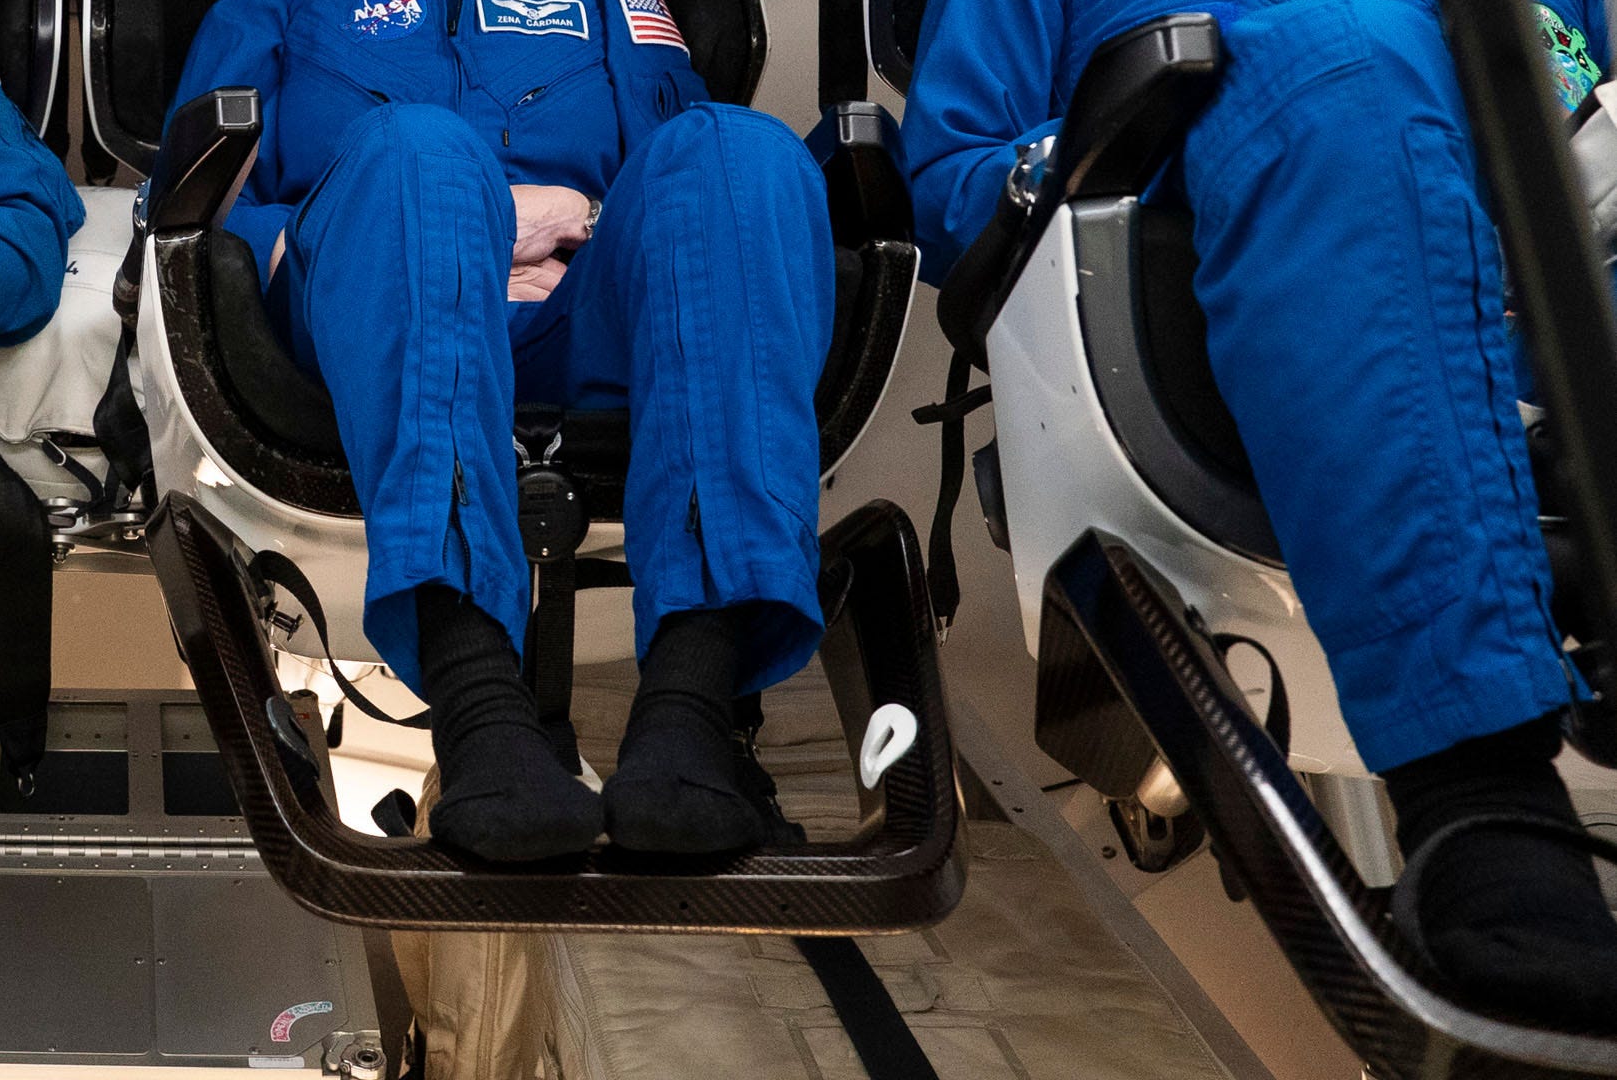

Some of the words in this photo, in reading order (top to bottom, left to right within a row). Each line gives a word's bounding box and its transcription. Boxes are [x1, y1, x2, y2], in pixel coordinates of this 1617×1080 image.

[354, 0, 423, 23] NASA
[497, 16, 521, 24] ZENA
[526, 18, 573, 27] CARDMAN
[65, 260, 79, 275] 4
